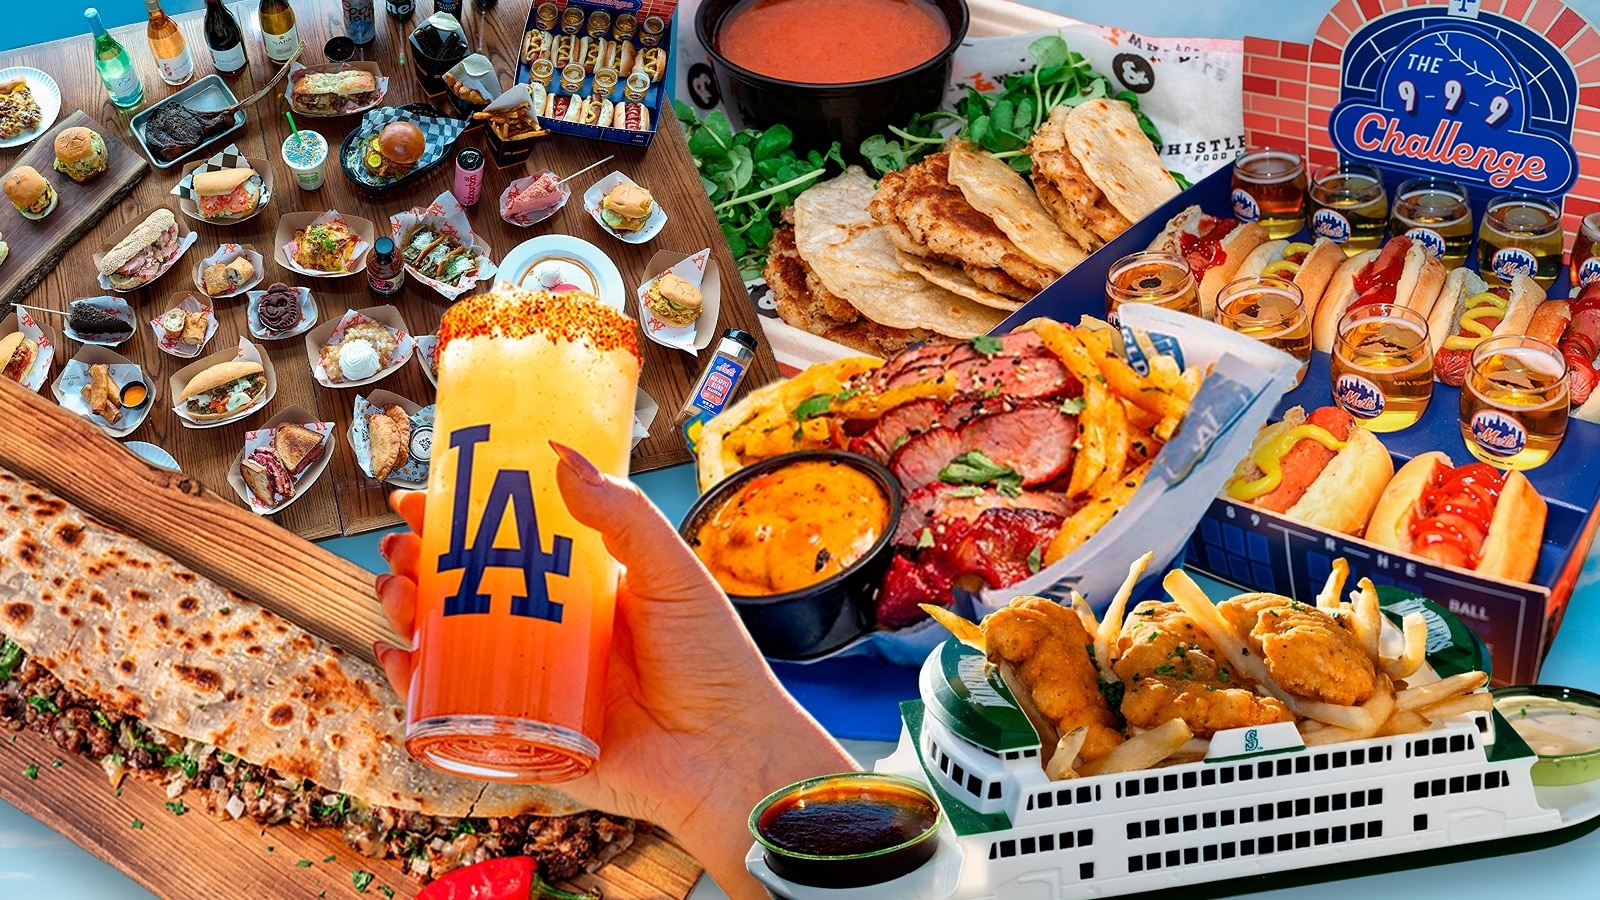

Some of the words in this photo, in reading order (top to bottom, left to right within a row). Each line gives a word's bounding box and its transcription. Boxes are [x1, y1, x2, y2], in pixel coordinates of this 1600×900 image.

[1409, 54, 1444, 74] THE
[1195, 152, 1227, 162] FOOD
[1354, 112, 1548, 188] Challenge
[1318, 220, 1345, 238] Mets
[1341, 389, 1377, 411] Mets
[1476, 427, 1517, 449] Mets
[437, 424, 573, 624] LA
[1226, 505, 1236, 519] 8
[1250, 513, 1261, 528] 9
[1325, 537, 1336, 551] R
[1377, 554, 1389, 570] H
[1405, 563, 1417, 579] E
[1448, 598, 1491, 621] BALL
